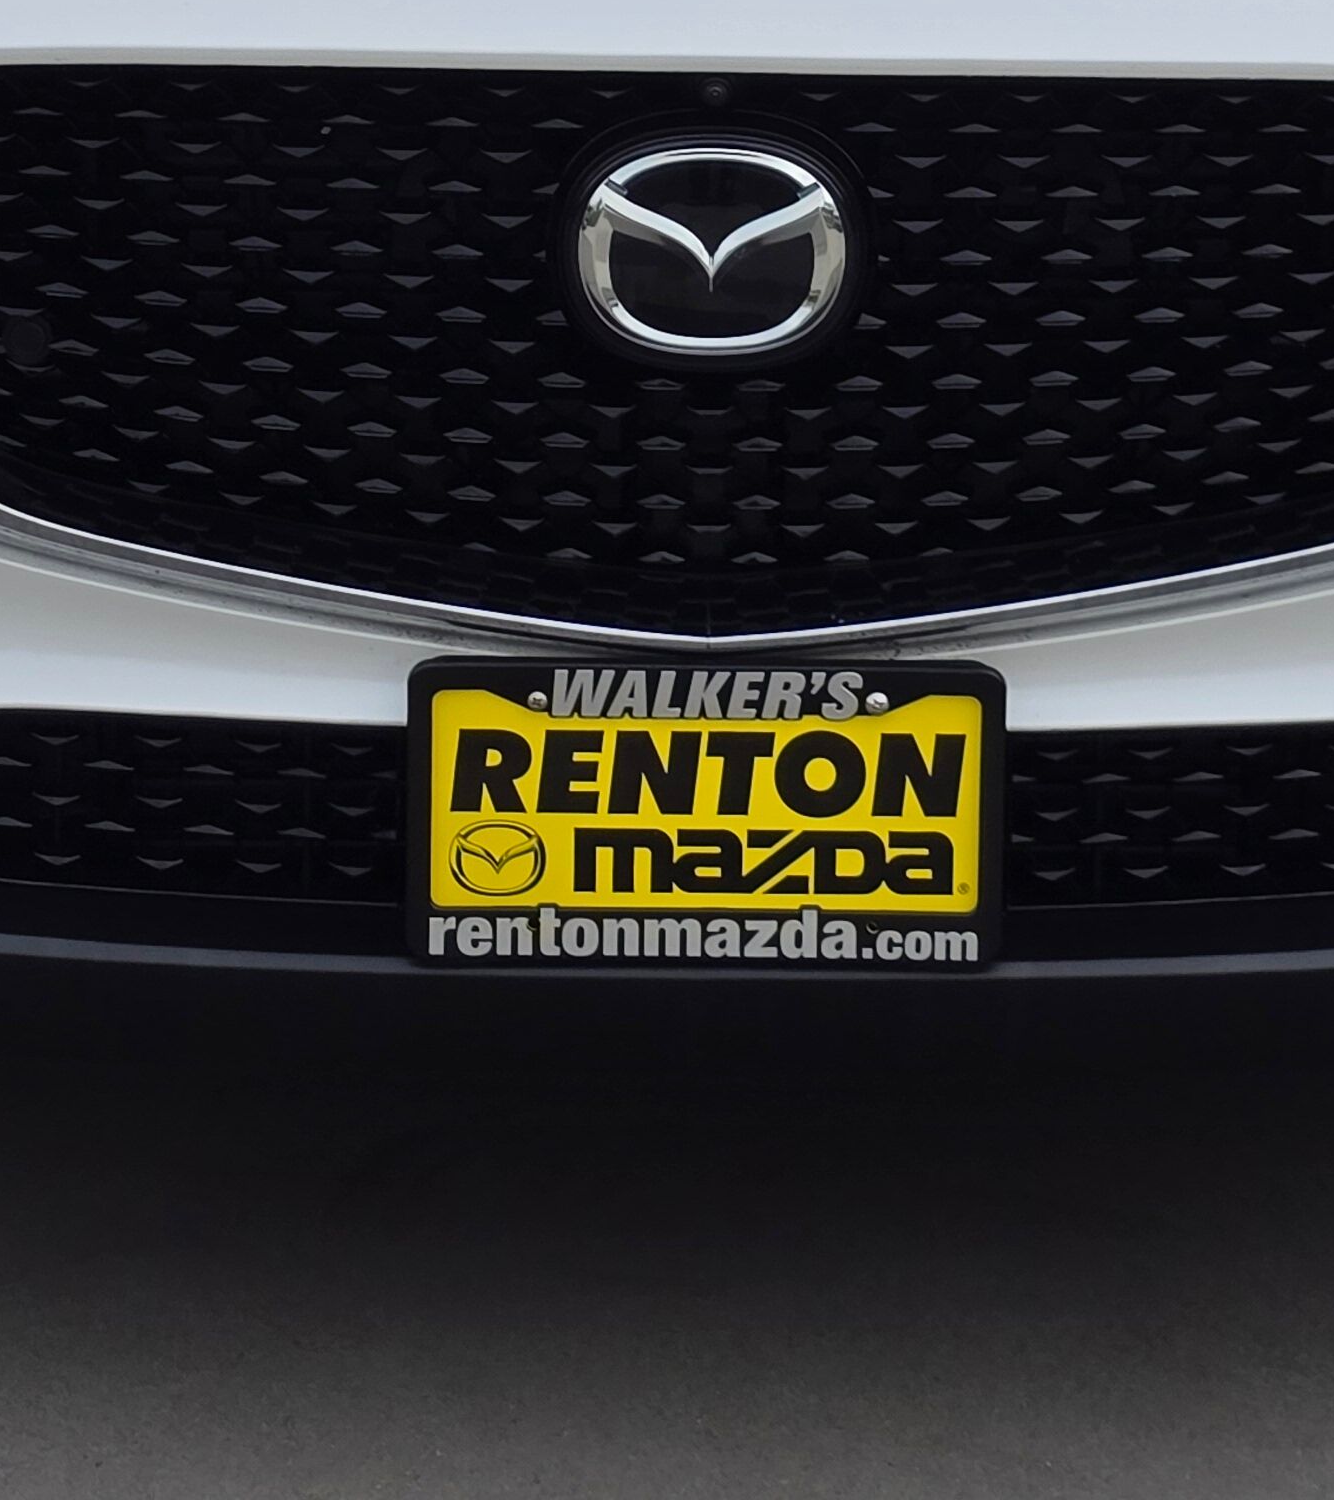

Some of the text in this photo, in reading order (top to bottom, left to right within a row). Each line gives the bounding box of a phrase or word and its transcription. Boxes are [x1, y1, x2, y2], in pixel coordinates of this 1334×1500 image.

[547, 669, 864, 720] WALKER'S
[450, 729, 966, 818] RENTON
[429, 907, 978, 962] rentonmazda.com
